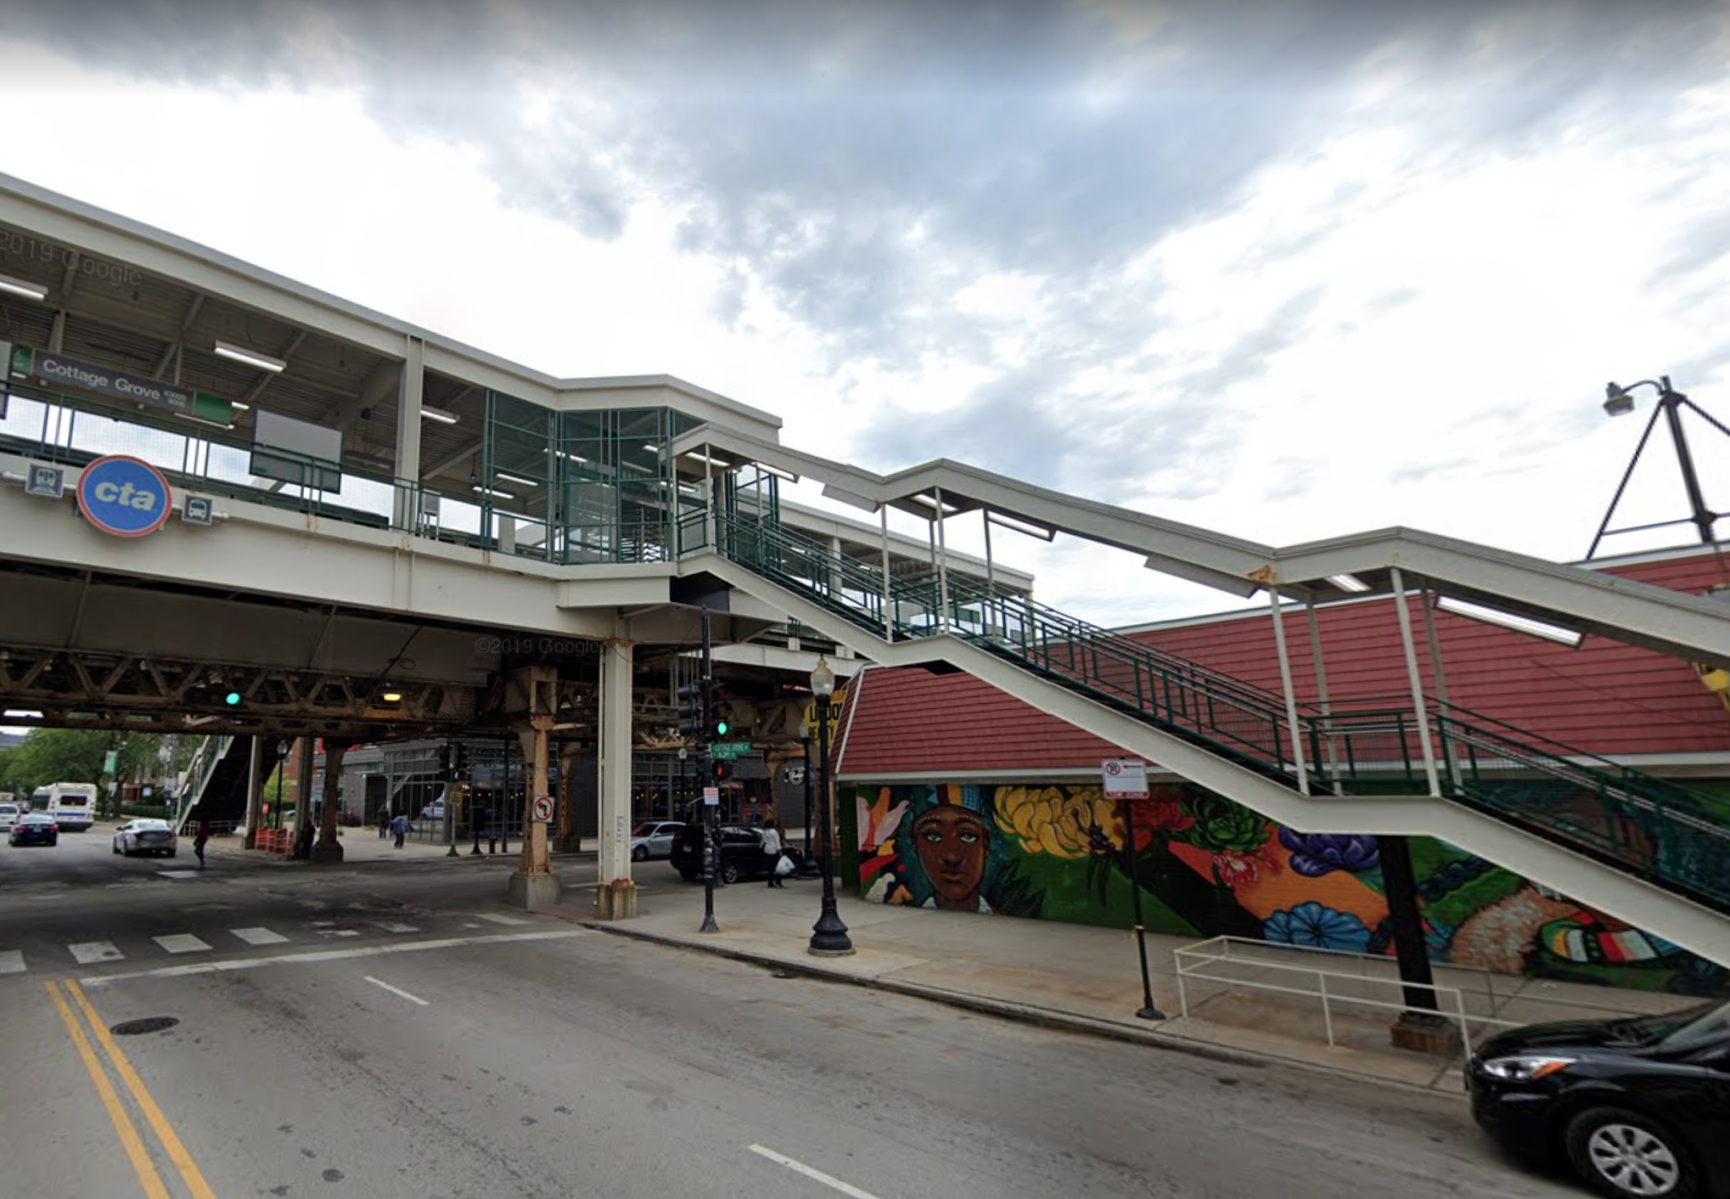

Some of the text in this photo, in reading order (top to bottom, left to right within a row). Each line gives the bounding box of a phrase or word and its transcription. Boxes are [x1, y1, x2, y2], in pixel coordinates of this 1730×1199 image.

[43, 359, 109, 387] Cottage
[115, 378, 161, 400] Grove
[95, 481, 156, 511] cta
